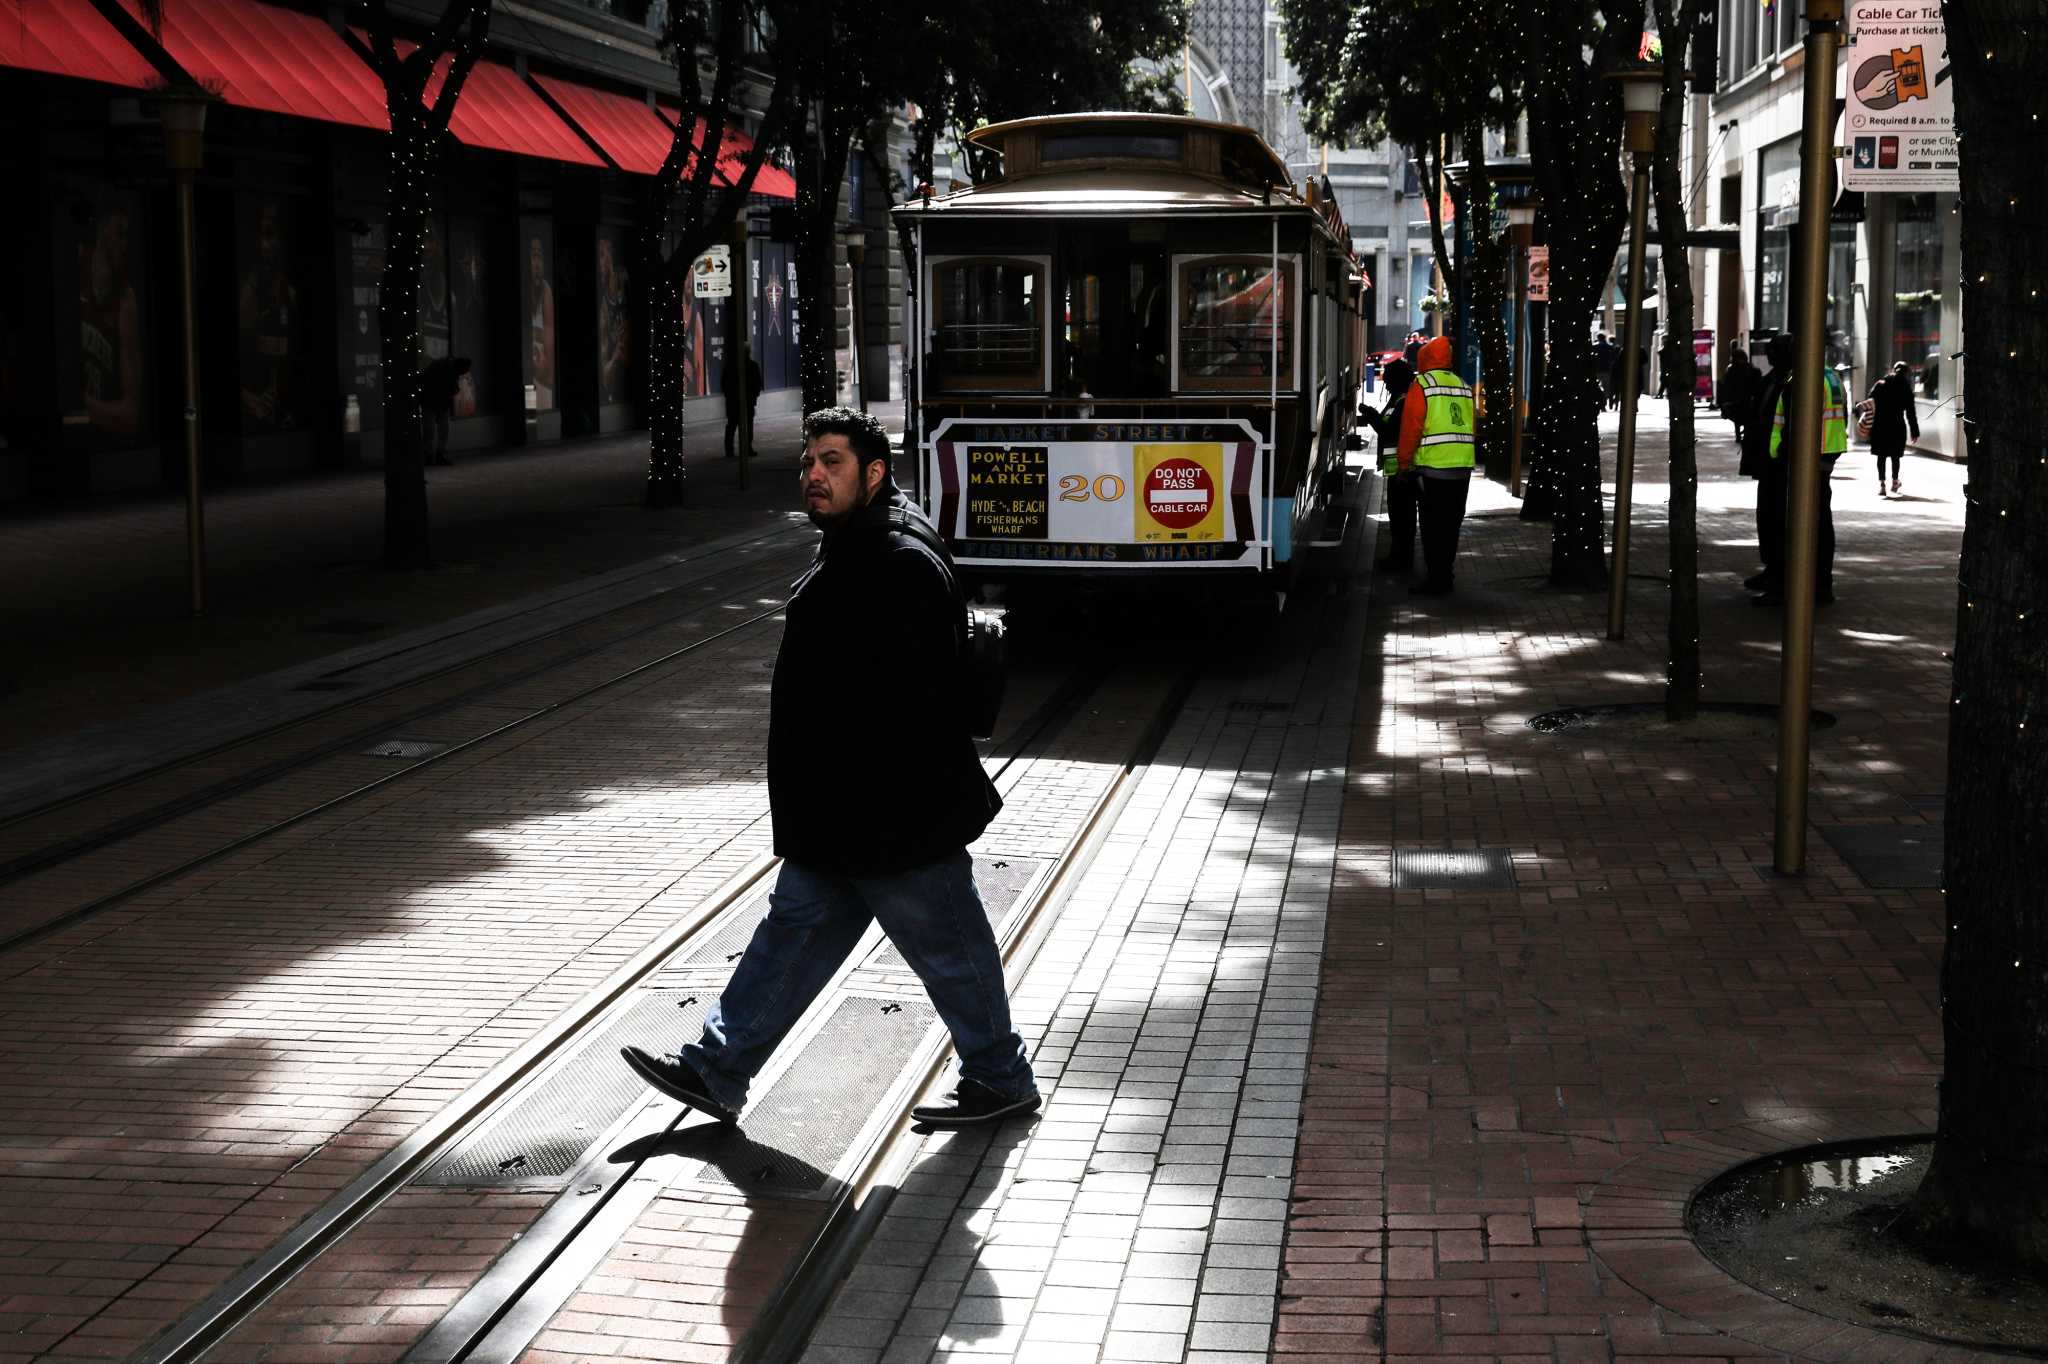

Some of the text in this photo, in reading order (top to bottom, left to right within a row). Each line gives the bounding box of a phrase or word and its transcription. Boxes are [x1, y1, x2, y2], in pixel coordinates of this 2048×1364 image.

[1857, 8, 1892, 19] Cable
[1896, 8, 1917, 19] Car
[1856, 26, 1897, 35] Purchase
[1900, 27, 1910, 35] at
[1913, 26, 1938, 35] ticket
[1869, 116, 1908, 126] Required
[1940, 117, 1950, 125] to
[975, 425, 1071, 441] MARKET
[1095, 424, 1191, 441] STREET
[972, 452, 1045, 463] POWELL
[991, 464, 1026, 473] AND
[1155, 467, 1202, 479] DO NOT
[971, 473, 1046, 485] MARKET
[1163, 478, 1195, 489] PASS
[1059, 474, 1126, 502] 20
[971, 500, 997, 513] HYDE
[1012, 500, 1045, 513] BEACH
[1150, 504, 1208, 513] CABLE CAR
[977, 515, 1038, 525] FISHERMANS
[991, 525, 1023, 534] WHARF
[964, 543, 1224, 561] FISHERMANS WHARF
